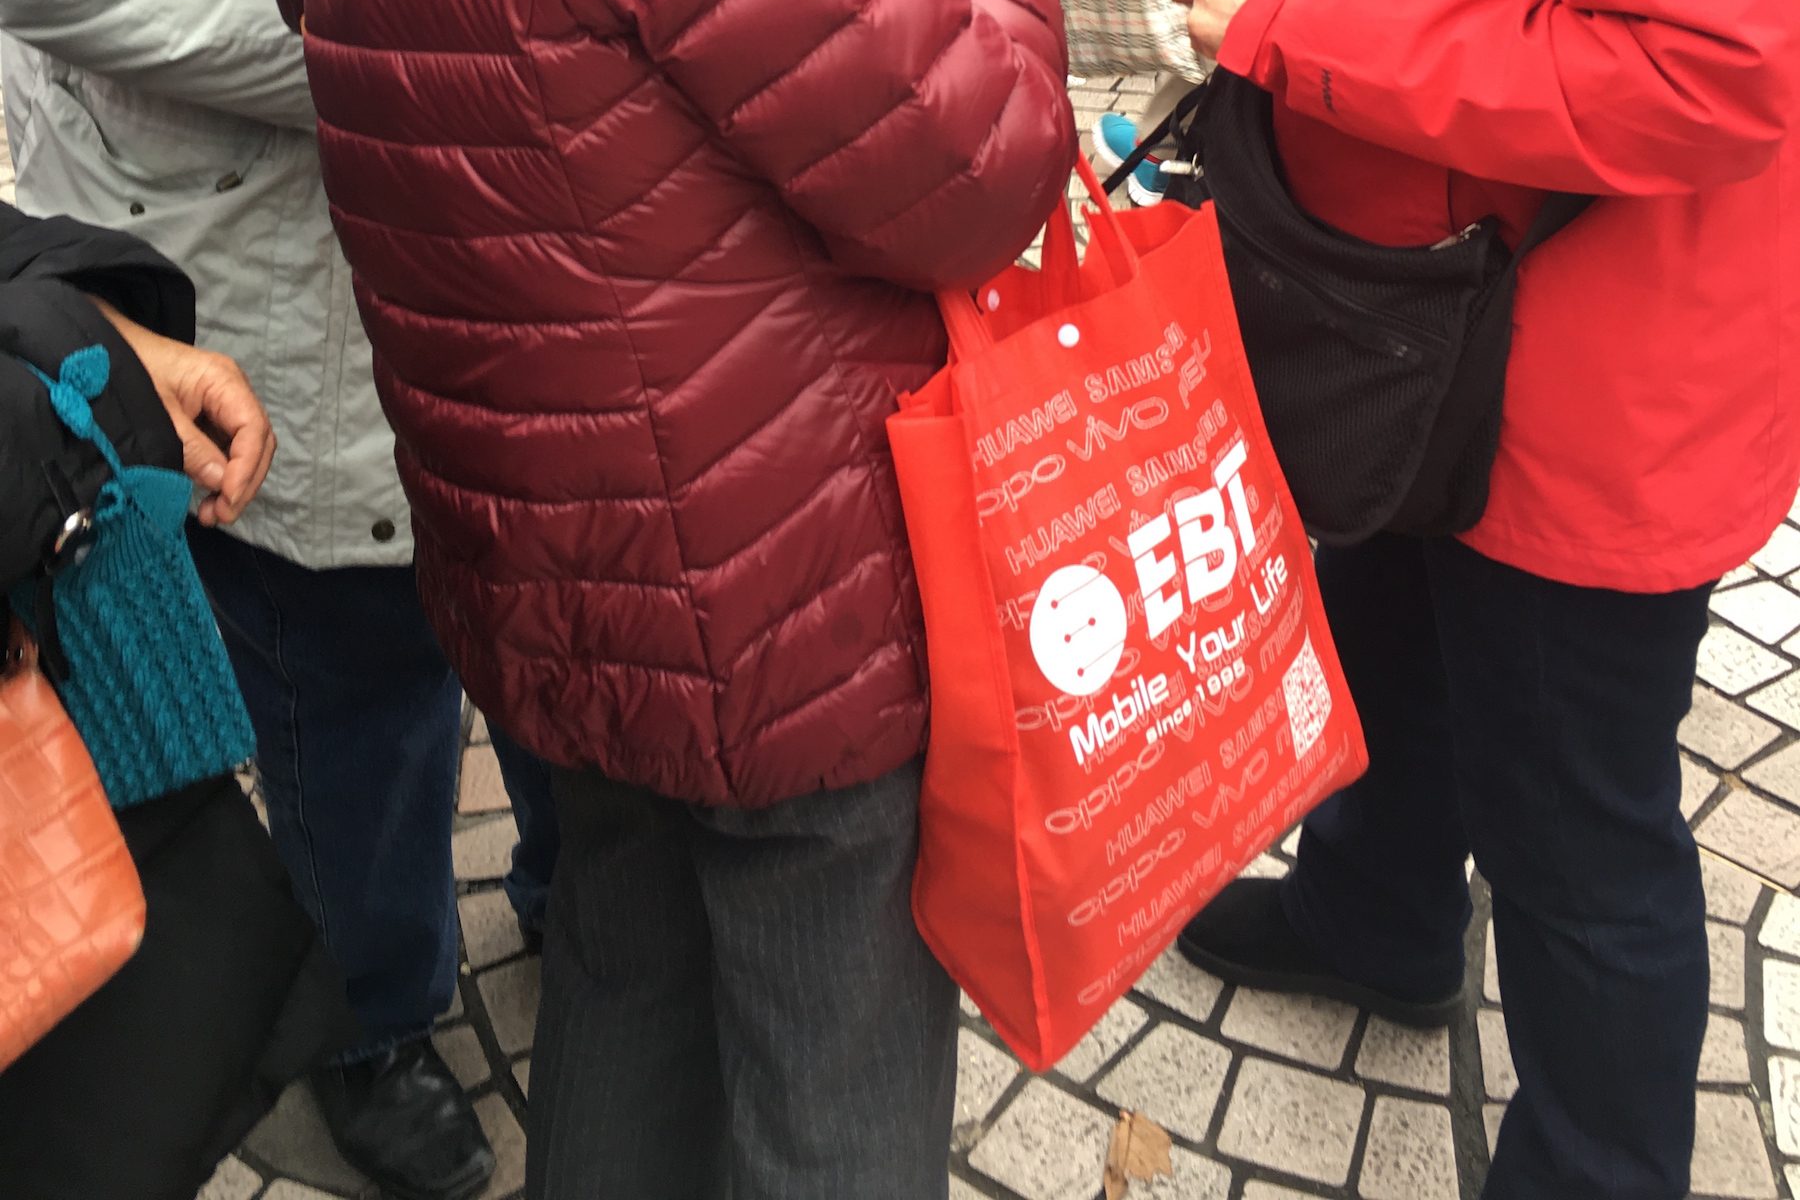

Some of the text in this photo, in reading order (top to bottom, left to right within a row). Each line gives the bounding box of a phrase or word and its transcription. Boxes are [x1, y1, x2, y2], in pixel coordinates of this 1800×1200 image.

[973, 389, 1078, 472] HUAWEI
[1004, 483, 1121, 576] HUAWEI
[1127, 440, 1256, 640] EBT
[1069, 673, 1170, 766] Mobile
[1176, 610, 1245, 673] Your
[1250, 554, 1288, 615] Life
[1106, 686, 1286, 866] HUAWEI SAMSU
[1118, 842, 1222, 947] HUAWEI
